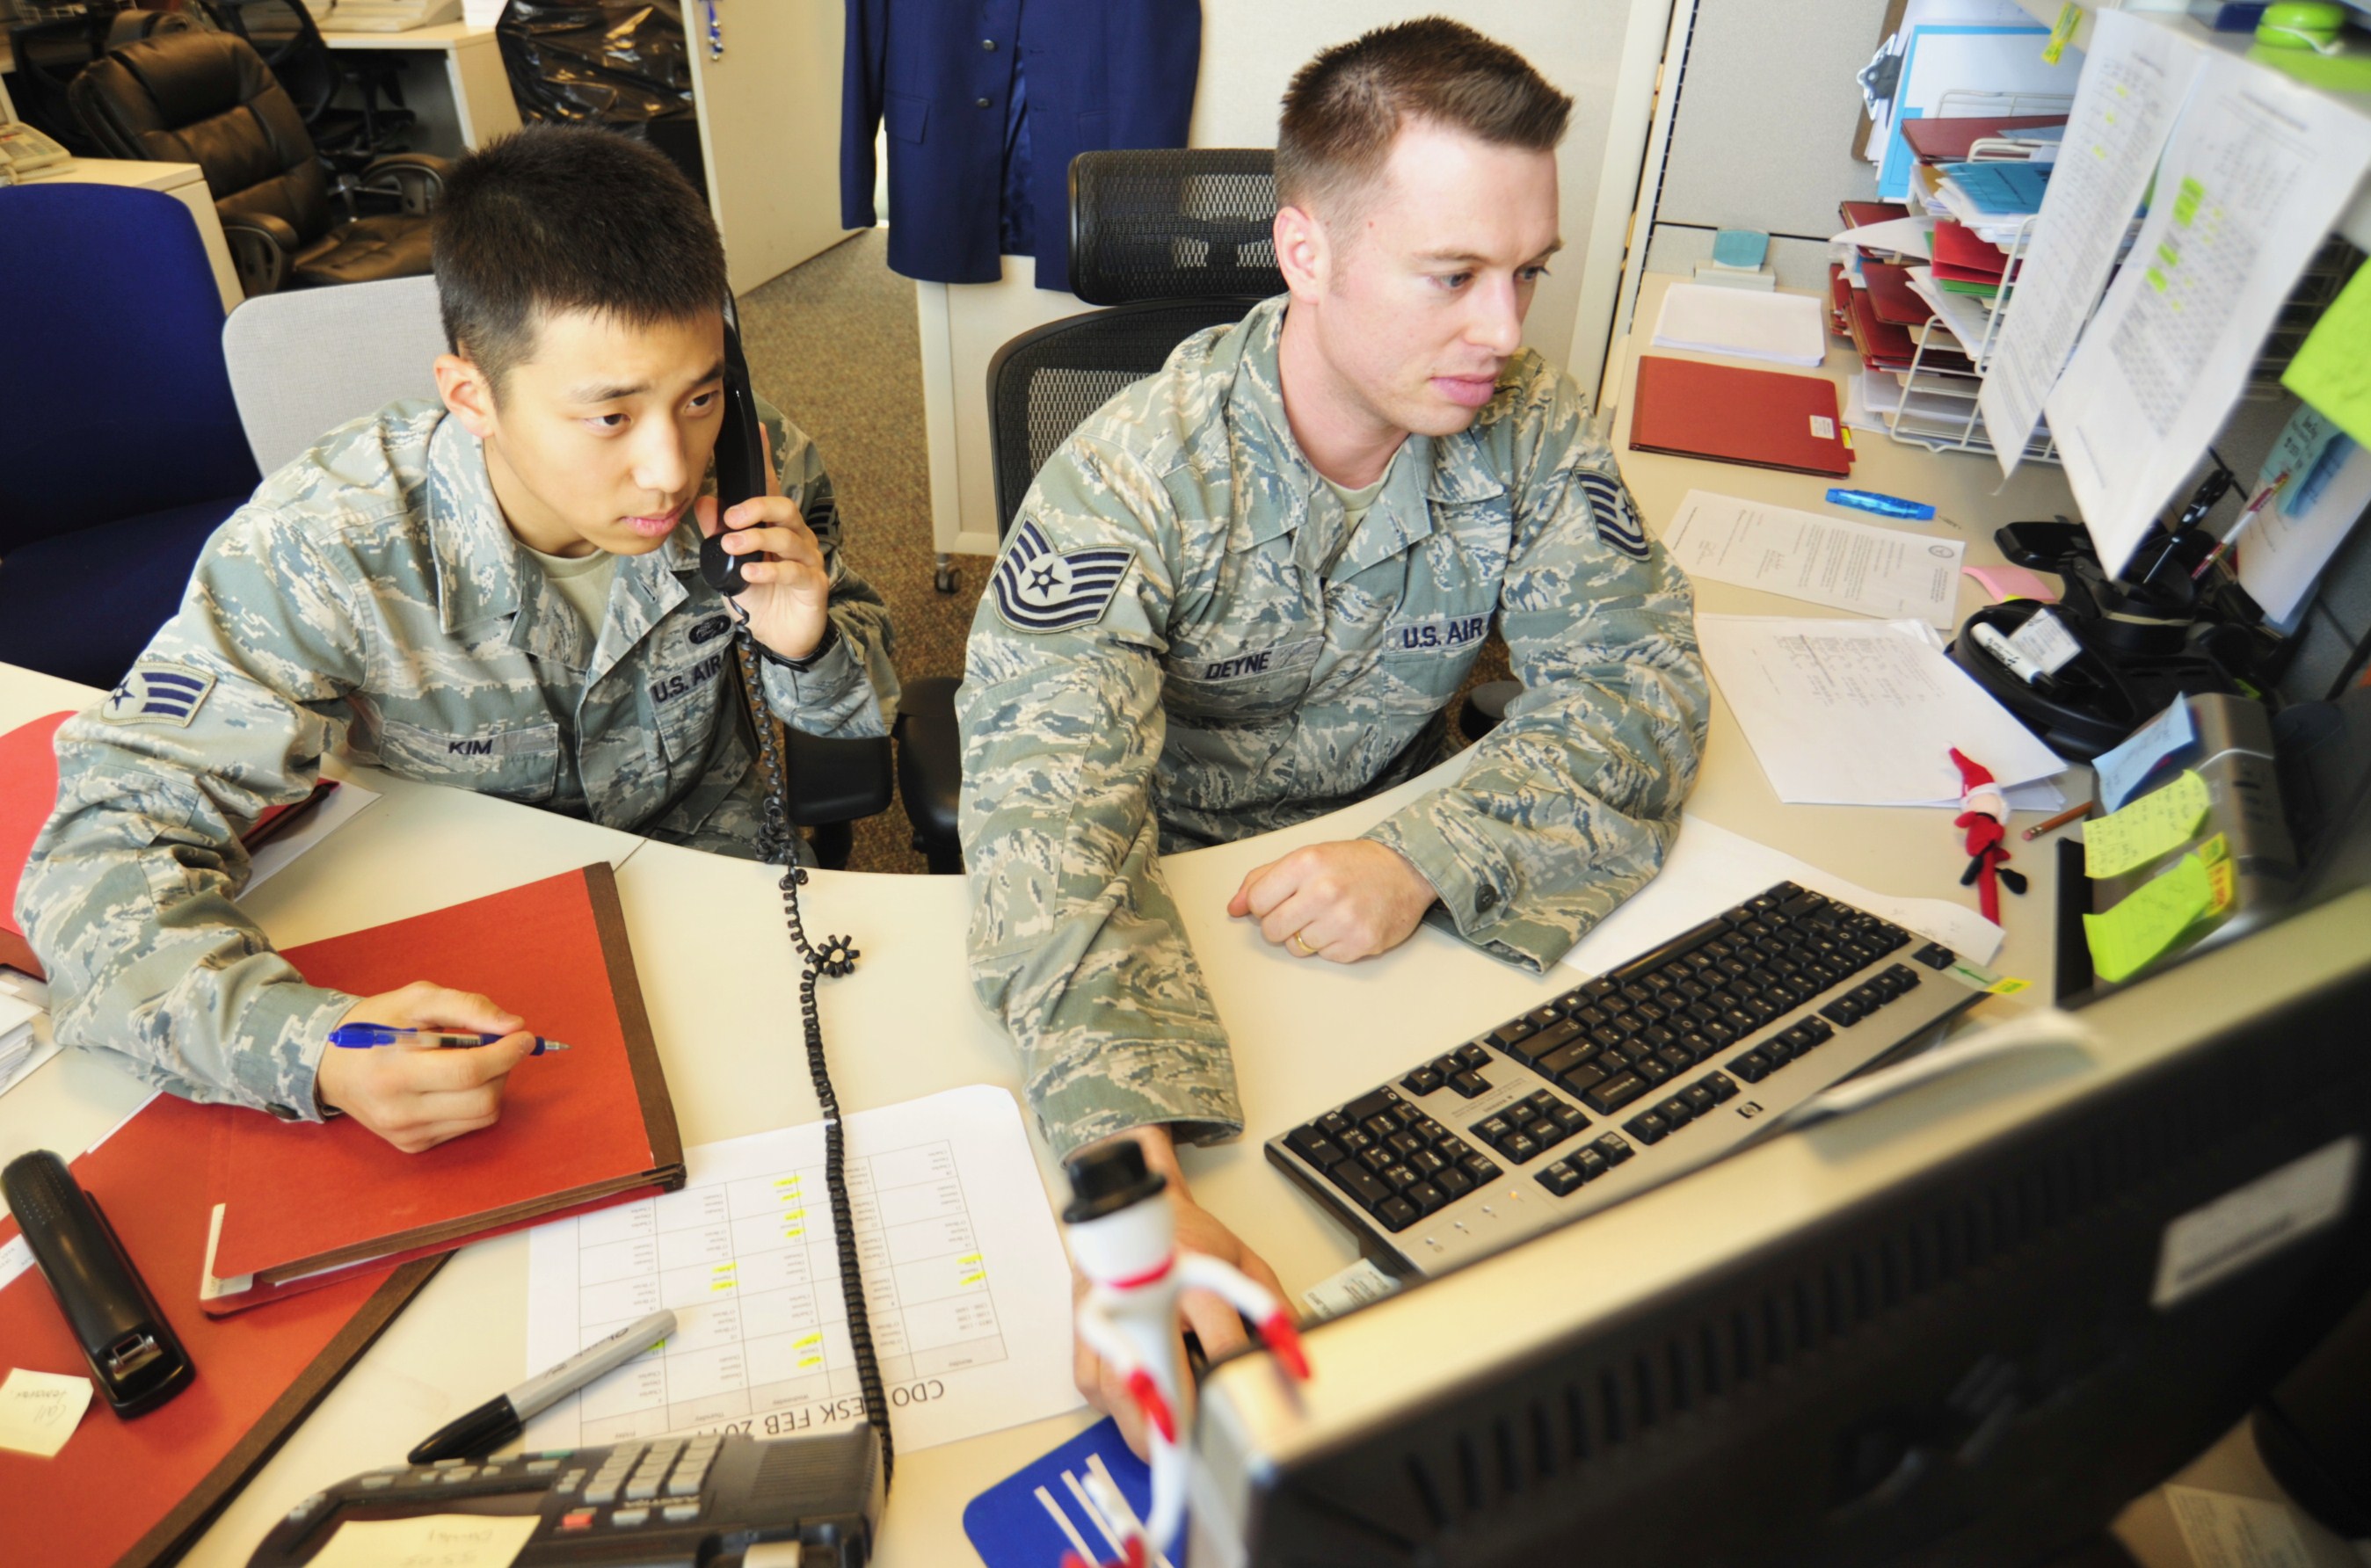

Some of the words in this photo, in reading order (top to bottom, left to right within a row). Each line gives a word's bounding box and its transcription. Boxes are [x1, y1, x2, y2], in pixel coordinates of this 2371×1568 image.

[1403, 625, 1442, 649] U.S.
[1448, 618, 1484, 645] AIR
[651, 675, 690, 703] U.S.
[692, 654, 722, 686] AIR
[1205, 651, 1272, 679] DEYNE
[448, 739, 493, 755] KIM
[890, 1378, 945, 1407] CDO
[762, 1408, 811, 1434] FEB
[818, 1395, 867, 1424] ESK
